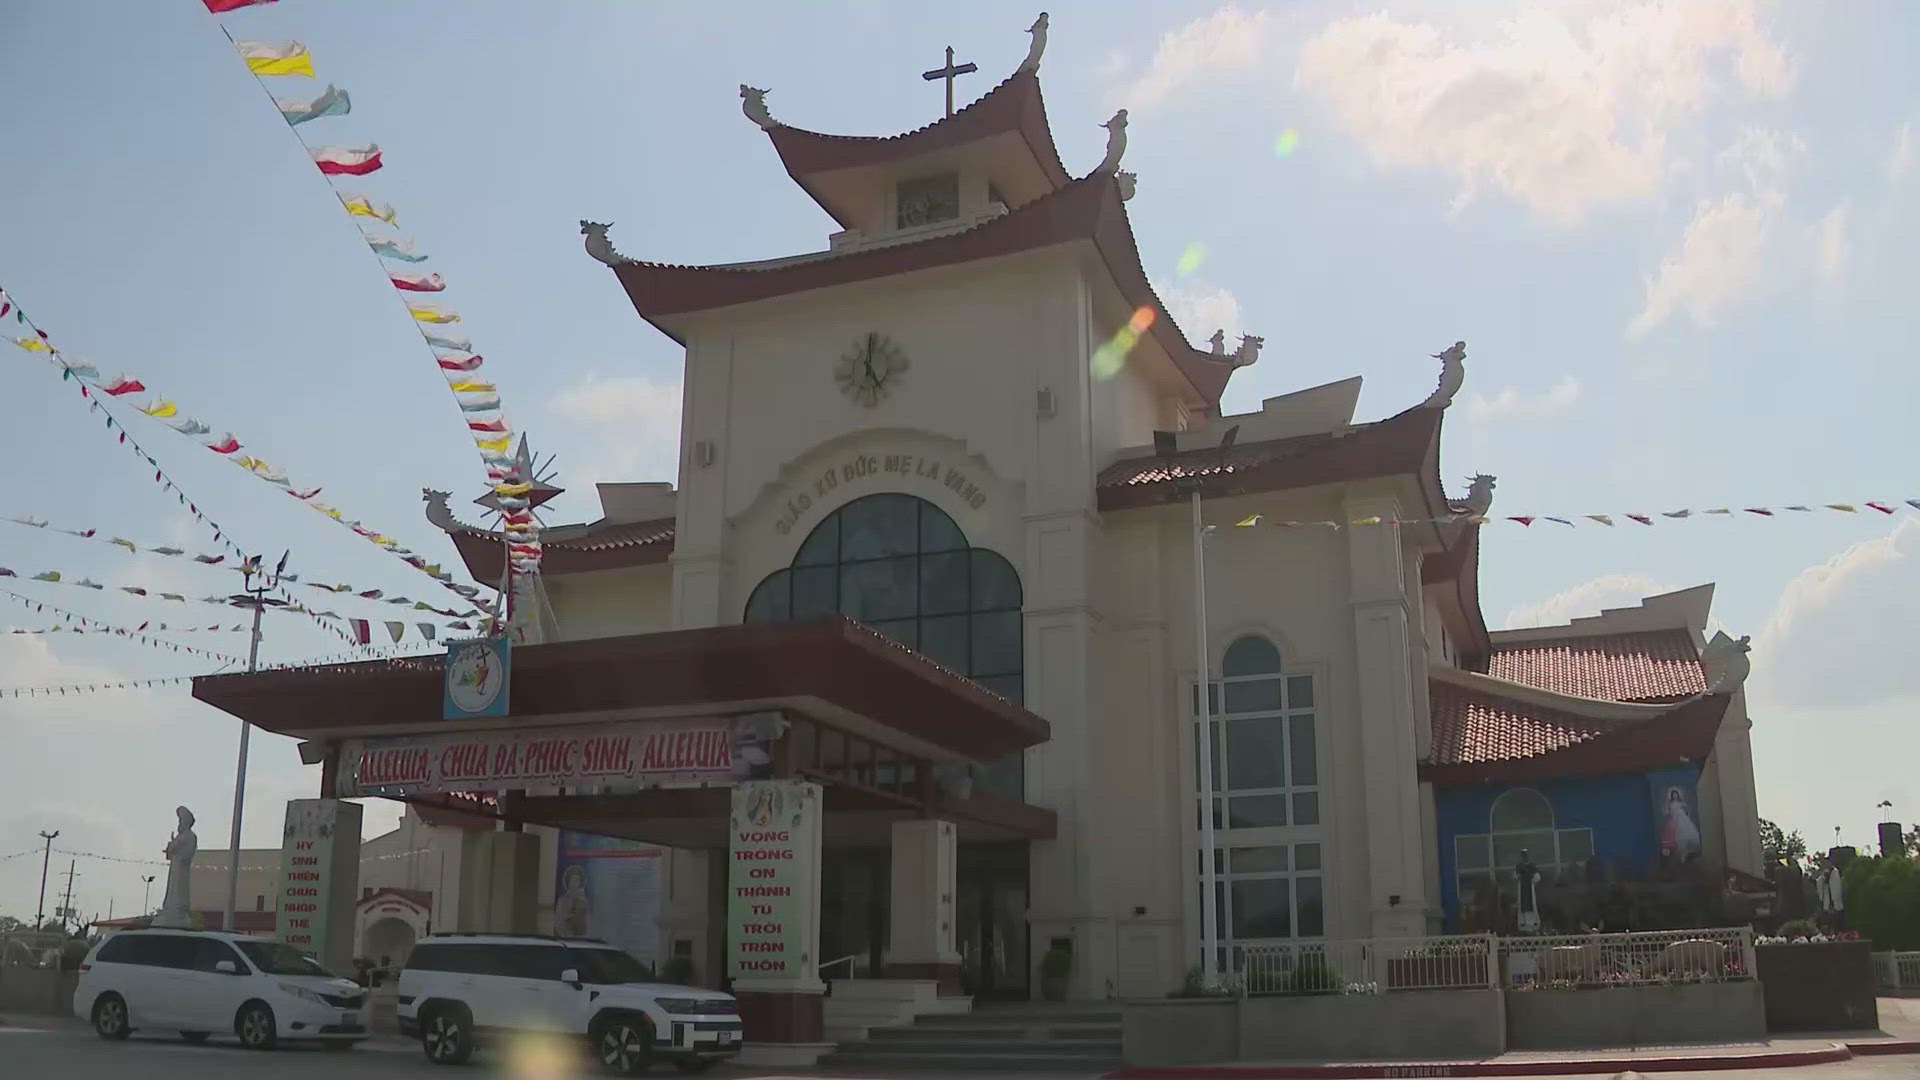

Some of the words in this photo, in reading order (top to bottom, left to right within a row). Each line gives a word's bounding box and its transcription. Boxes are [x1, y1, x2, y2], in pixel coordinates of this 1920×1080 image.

[916, 457, 940, 480] LA
[943, 466, 987, 510] VANG
[642, 731, 732, 769] ALLELUIA
[1384, 1067, 1399, 1078] NO
[1402, 1066, 1451, 1078] PARKING
